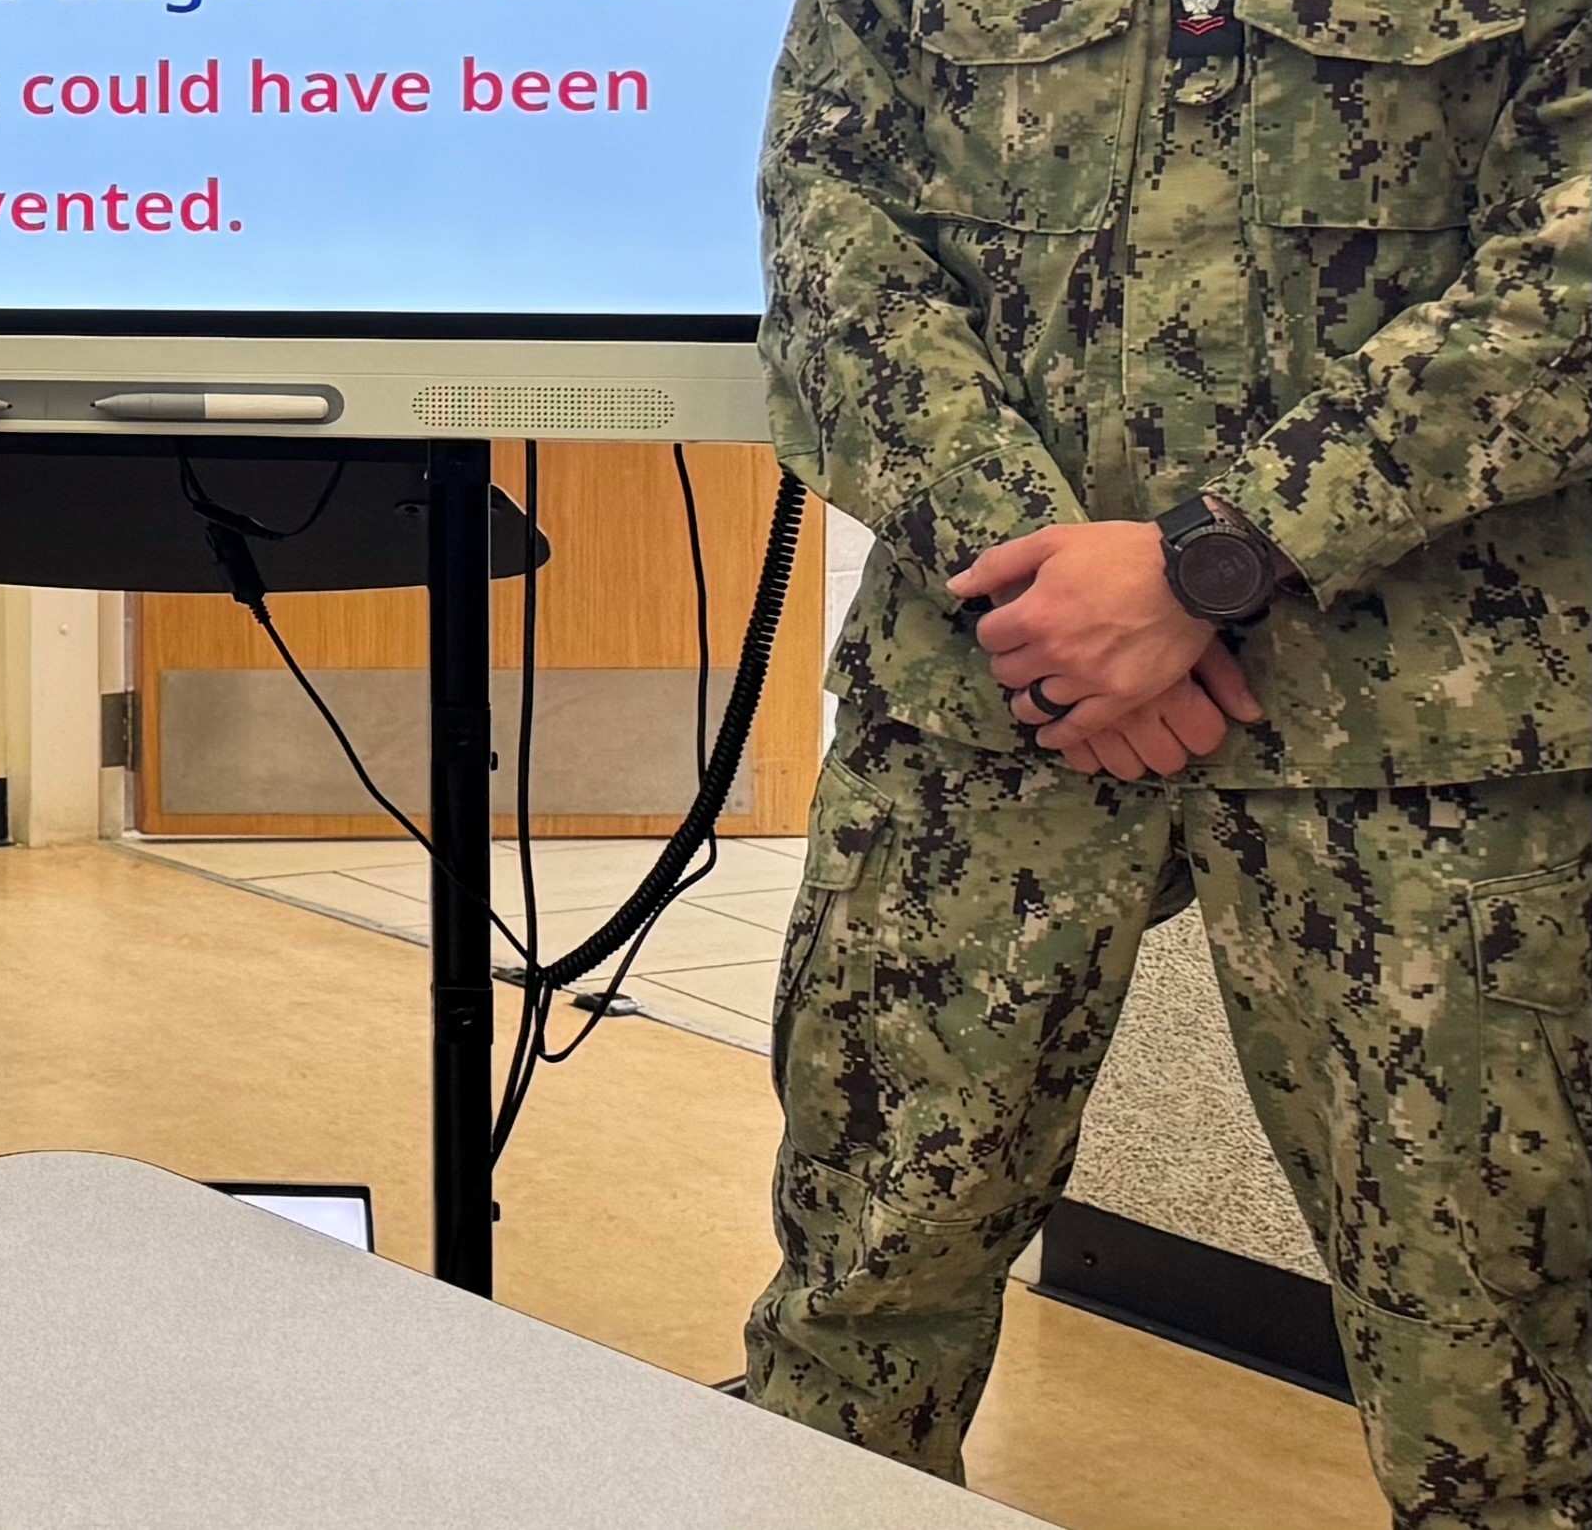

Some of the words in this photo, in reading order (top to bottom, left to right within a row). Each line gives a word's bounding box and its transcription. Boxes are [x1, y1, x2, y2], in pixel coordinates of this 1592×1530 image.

[22, 58, 219, 115] could
[251, 58, 431, 113] have
[463, 56, 648, 112] been
